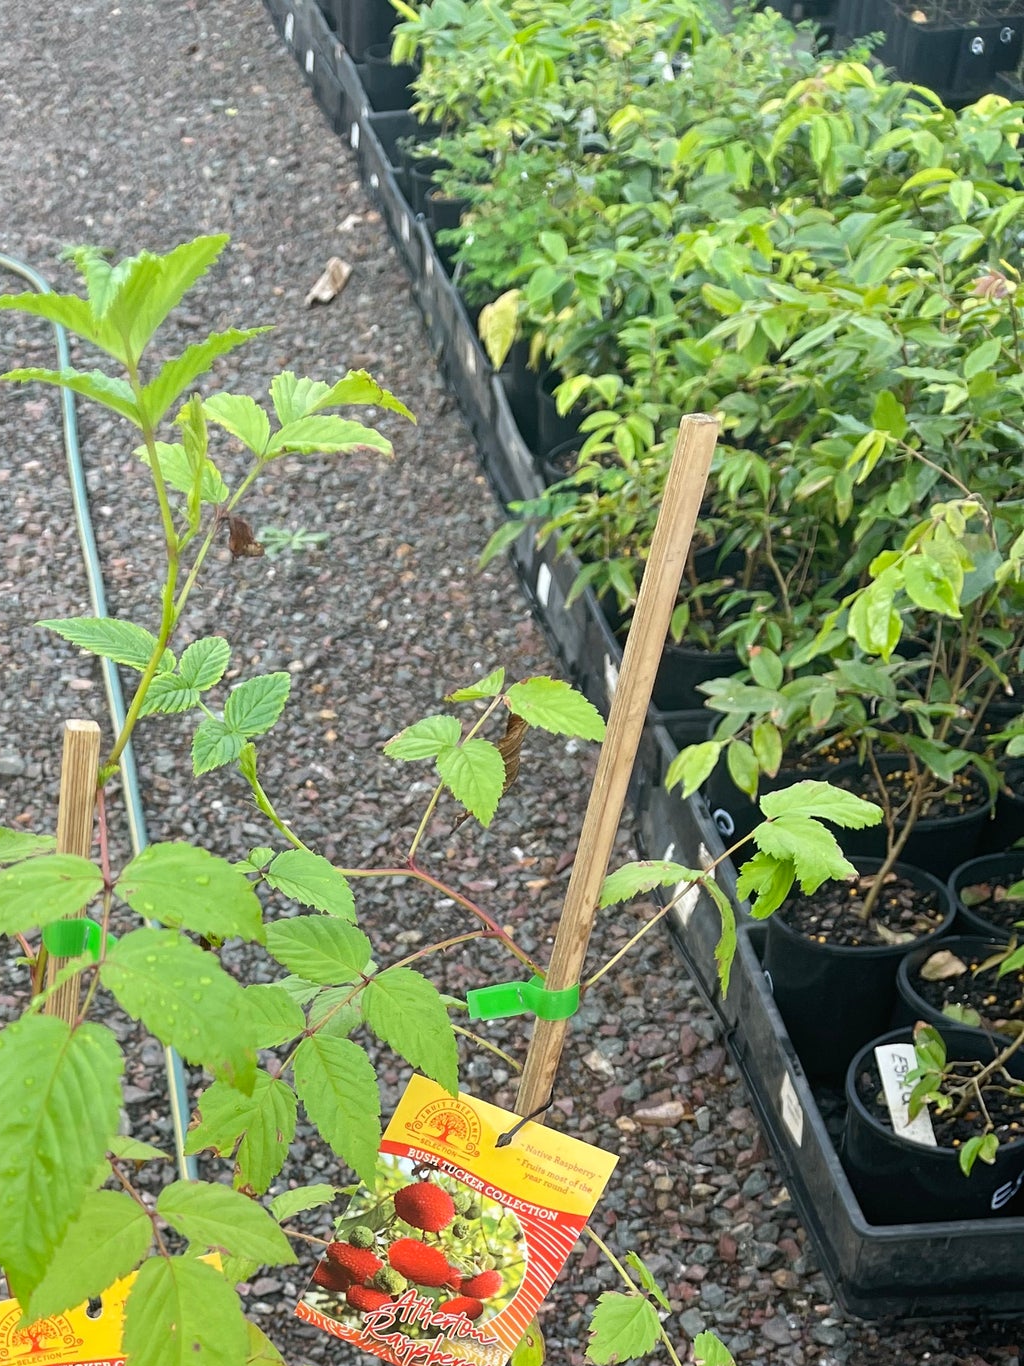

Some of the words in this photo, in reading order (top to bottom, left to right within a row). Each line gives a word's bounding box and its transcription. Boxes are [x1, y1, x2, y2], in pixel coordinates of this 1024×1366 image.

[421, 1101, 446, 1119] FRUIT
[420, 1138, 457, 1157] SELECTION
[521, 1159, 545, 1174] Fruits
[547, 1171, 568, 1183] most
[569, 1180, 580, 1188] of
[579, 1183, 593, 1193] the
[525, 1144, 553, 1161] Native
[553, 1155, 596, 1180] Raspberry
[407, 1147, 440, 1167] BUSH
[441, 1160, 486, 1191] TUCKER
[485, 1186, 559, 1221] COLLECTION
[523, 1172, 542, 1183] year
[543, 1180, 569, 1195] round
[0, 1316, 17, 1344] FRUIT
[379, 1288, 498, 1344] Atherton
[16, 1352, 62, 1366] SELECTION
